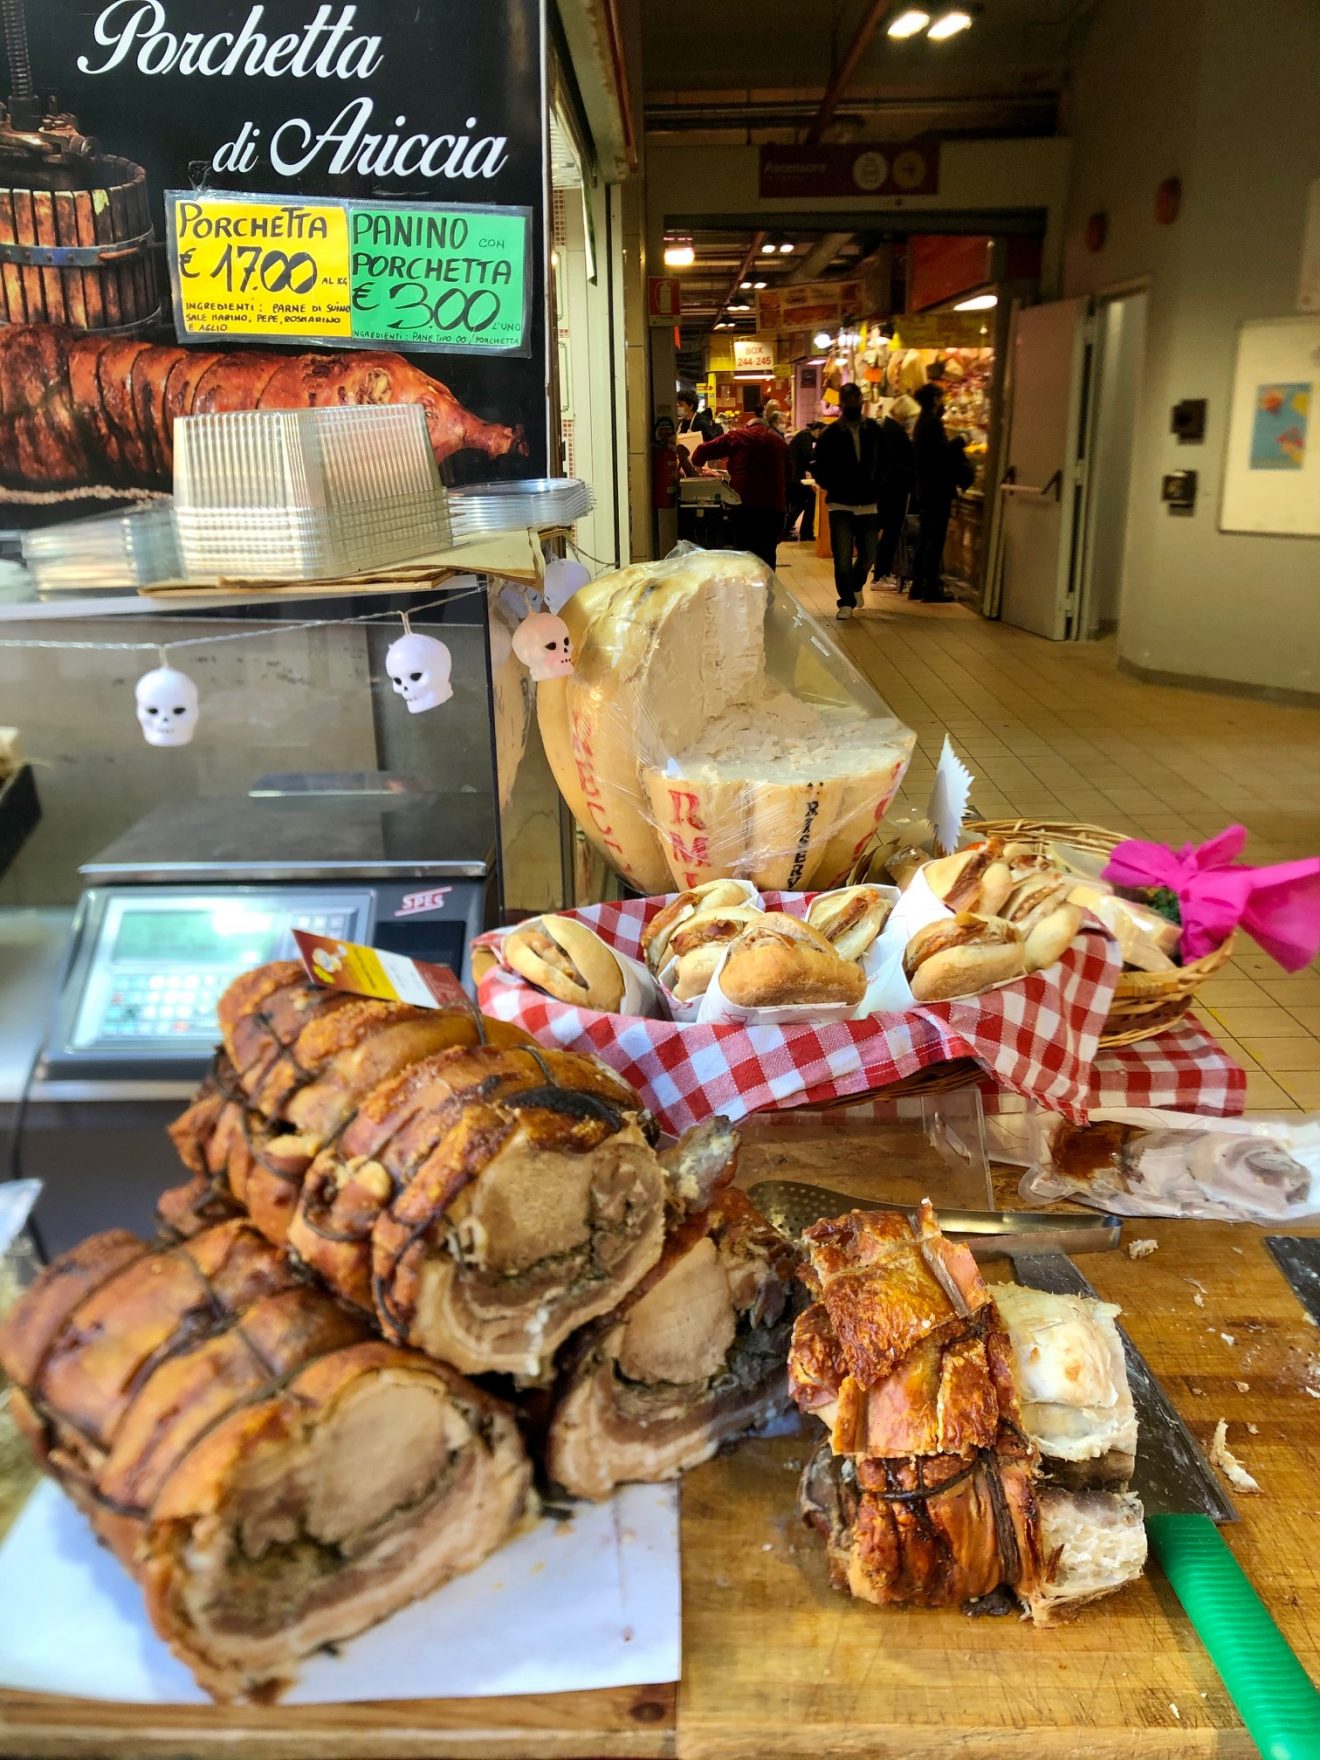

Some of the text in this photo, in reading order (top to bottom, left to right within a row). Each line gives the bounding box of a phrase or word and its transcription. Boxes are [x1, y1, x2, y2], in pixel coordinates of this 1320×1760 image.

[77, 0, 384, 80] Porchetta
[212, 97, 508, 179] di Ariccia
[179, 203, 328, 239] PORCHETTA
[353, 213, 505, 250] PANINO CON
[321, 277, 335, 285] AL
[352, 252, 512, 285] PORCHETTA
[186, 314, 207, 322] SALE
[284, 315, 341, 324] ROSMARINO
[745, 346, 763, 355] BOX
